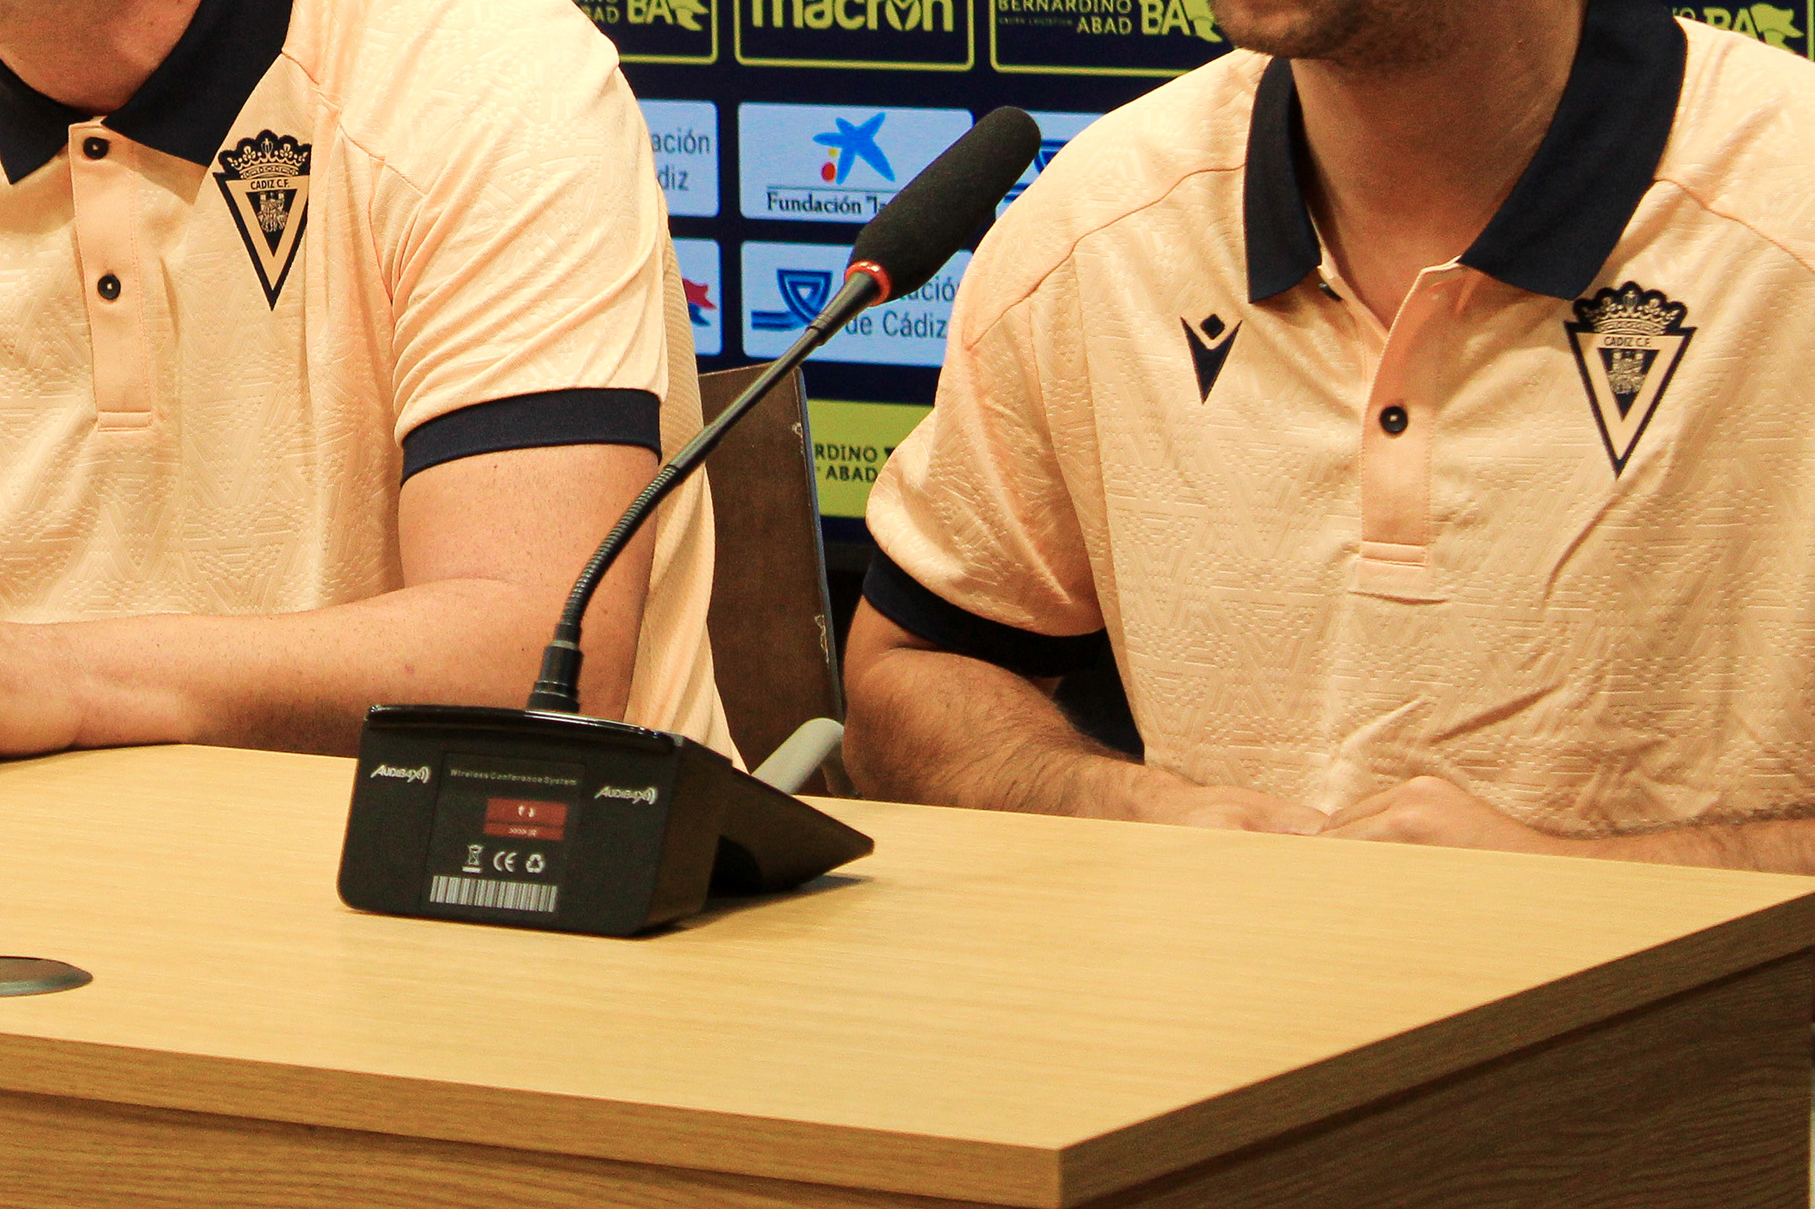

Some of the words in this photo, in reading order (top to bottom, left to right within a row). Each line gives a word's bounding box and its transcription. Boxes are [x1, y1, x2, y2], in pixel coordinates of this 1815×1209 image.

[1076, 15, 1133, 35] ABAD
[766, 191, 861, 215] Fundación
[845, 314, 873, 336] de
[882, 310, 948, 339] Cádiz
[826, 464, 878, 484] ABAD
